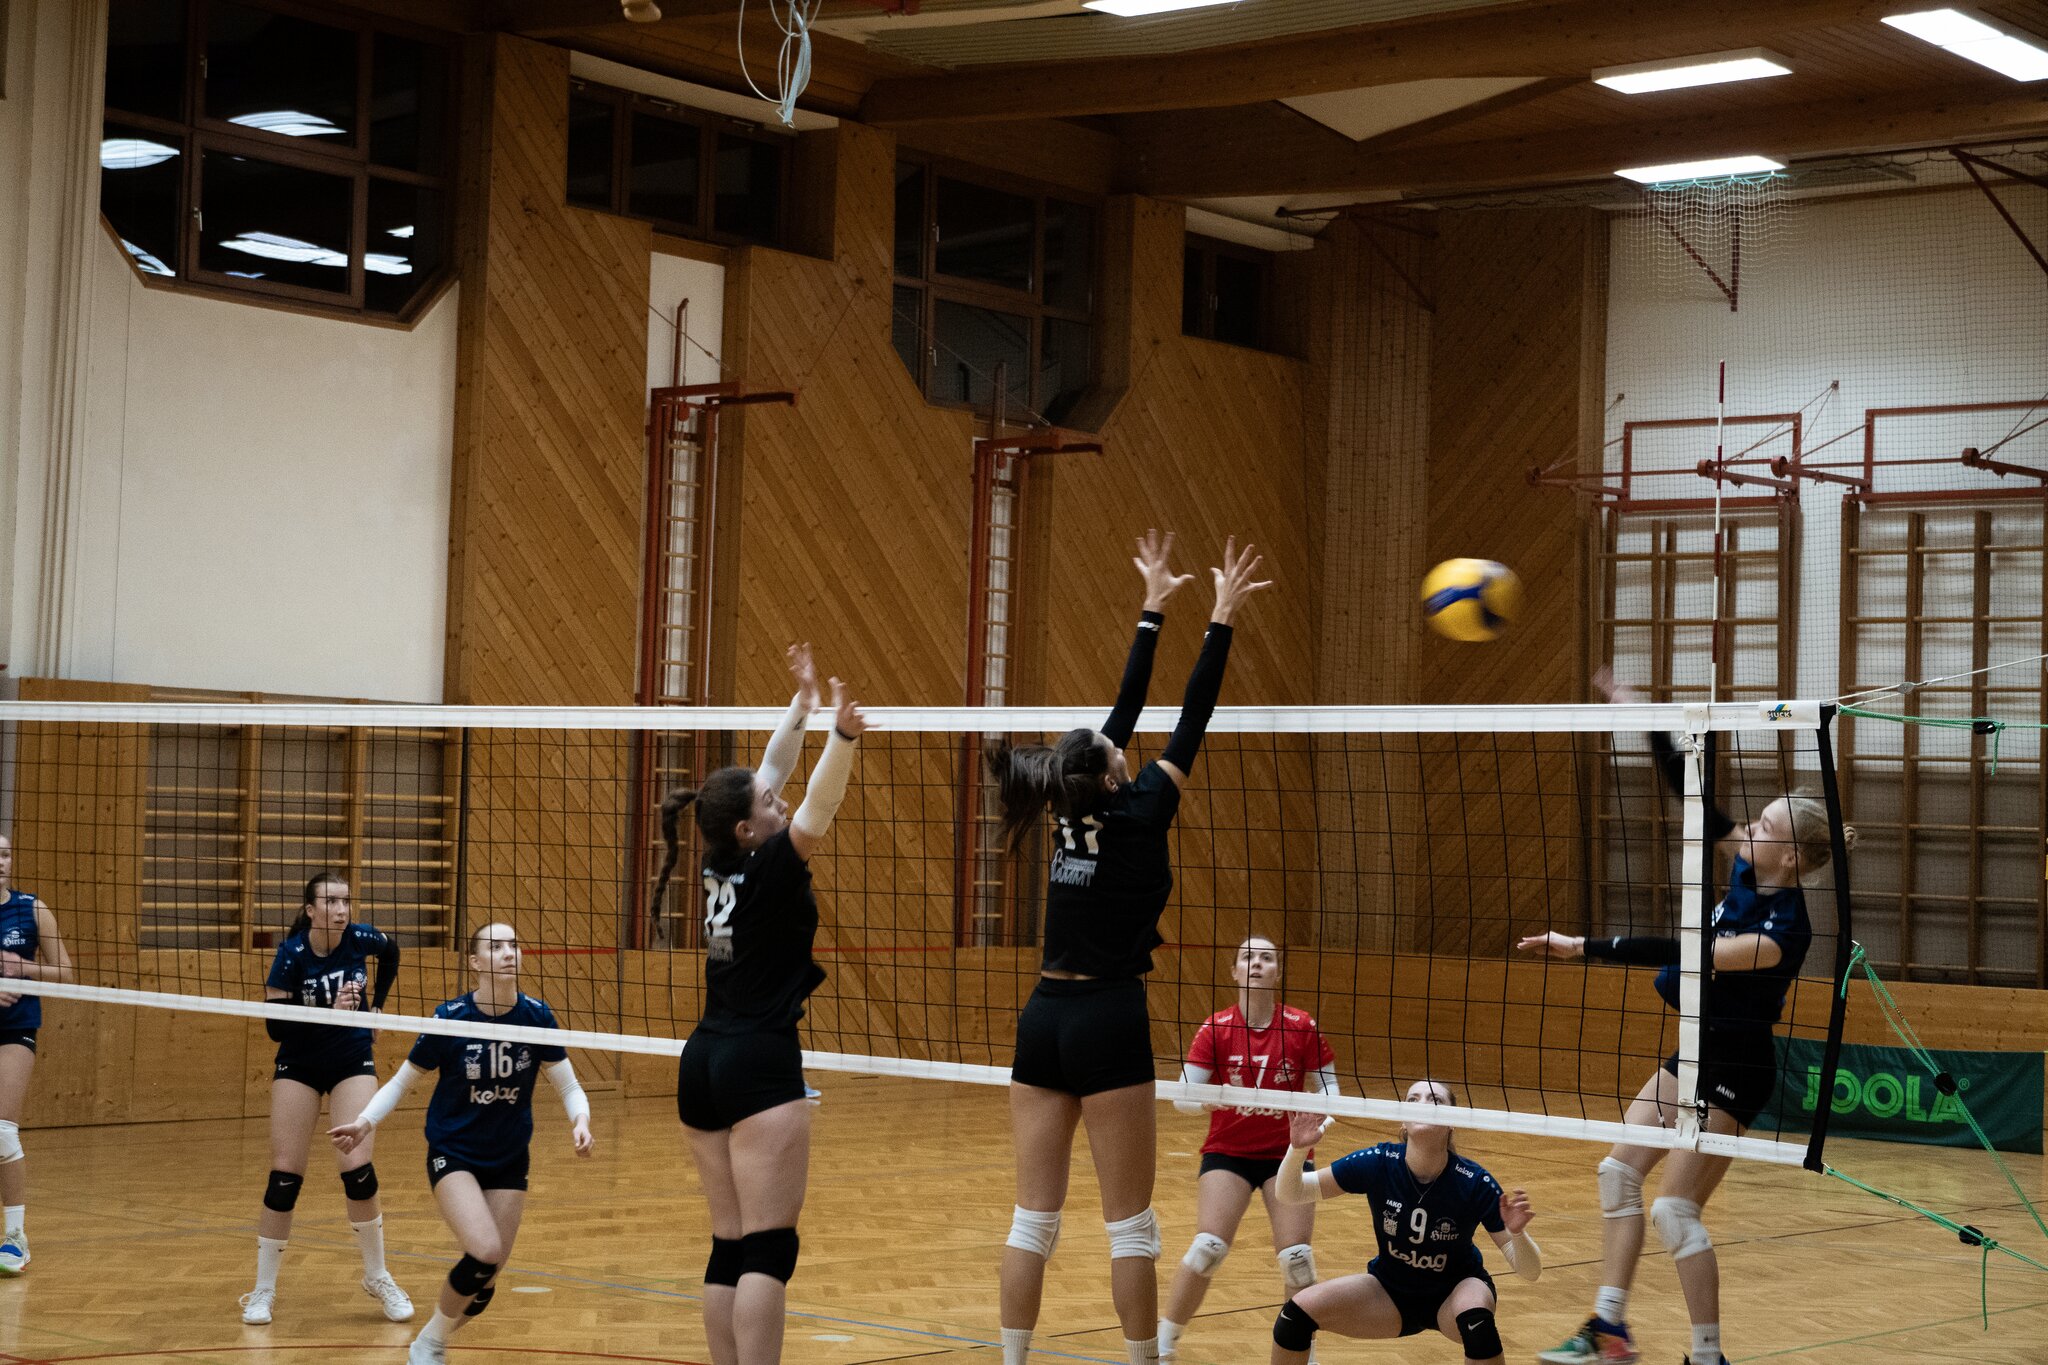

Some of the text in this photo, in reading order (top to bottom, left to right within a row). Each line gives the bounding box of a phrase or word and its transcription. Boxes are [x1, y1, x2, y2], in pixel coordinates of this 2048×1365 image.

[320, 970, 345, 1005] 17
[487, 1041, 514, 1079] 16
[470, 1084, 521, 1105] kelag
[1802, 1065, 1960, 1124] JOOLA
[1408, 1207, 1428, 1245] 9
[1387, 1240, 1448, 1273] kelag
